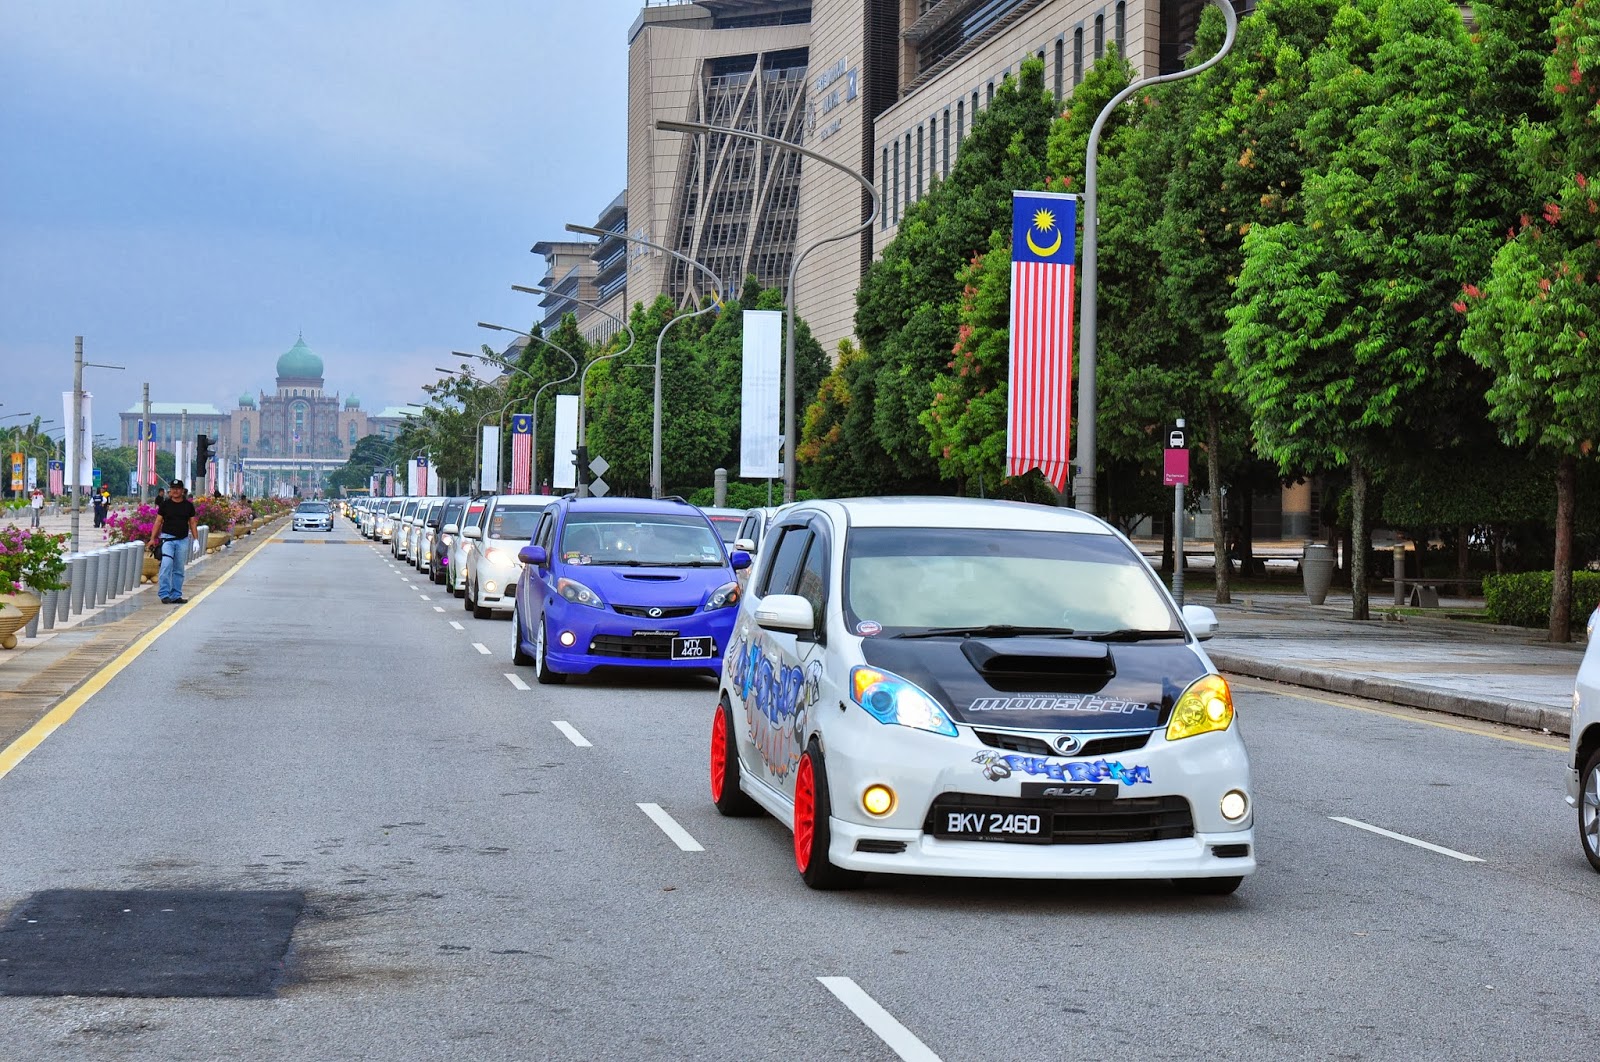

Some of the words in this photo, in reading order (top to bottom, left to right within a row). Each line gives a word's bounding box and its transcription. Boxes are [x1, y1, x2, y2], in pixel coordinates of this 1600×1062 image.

[683, 639, 701, 648] WTY
[681, 647, 703, 656] 4470
[969, 694, 1148, 715] monster
[1001, 754, 1066, 783] RICE
[1043, 787, 1097, 797] ALZA
[947, 812, 986, 833] BKV
[988, 813, 1041, 834] 2460
